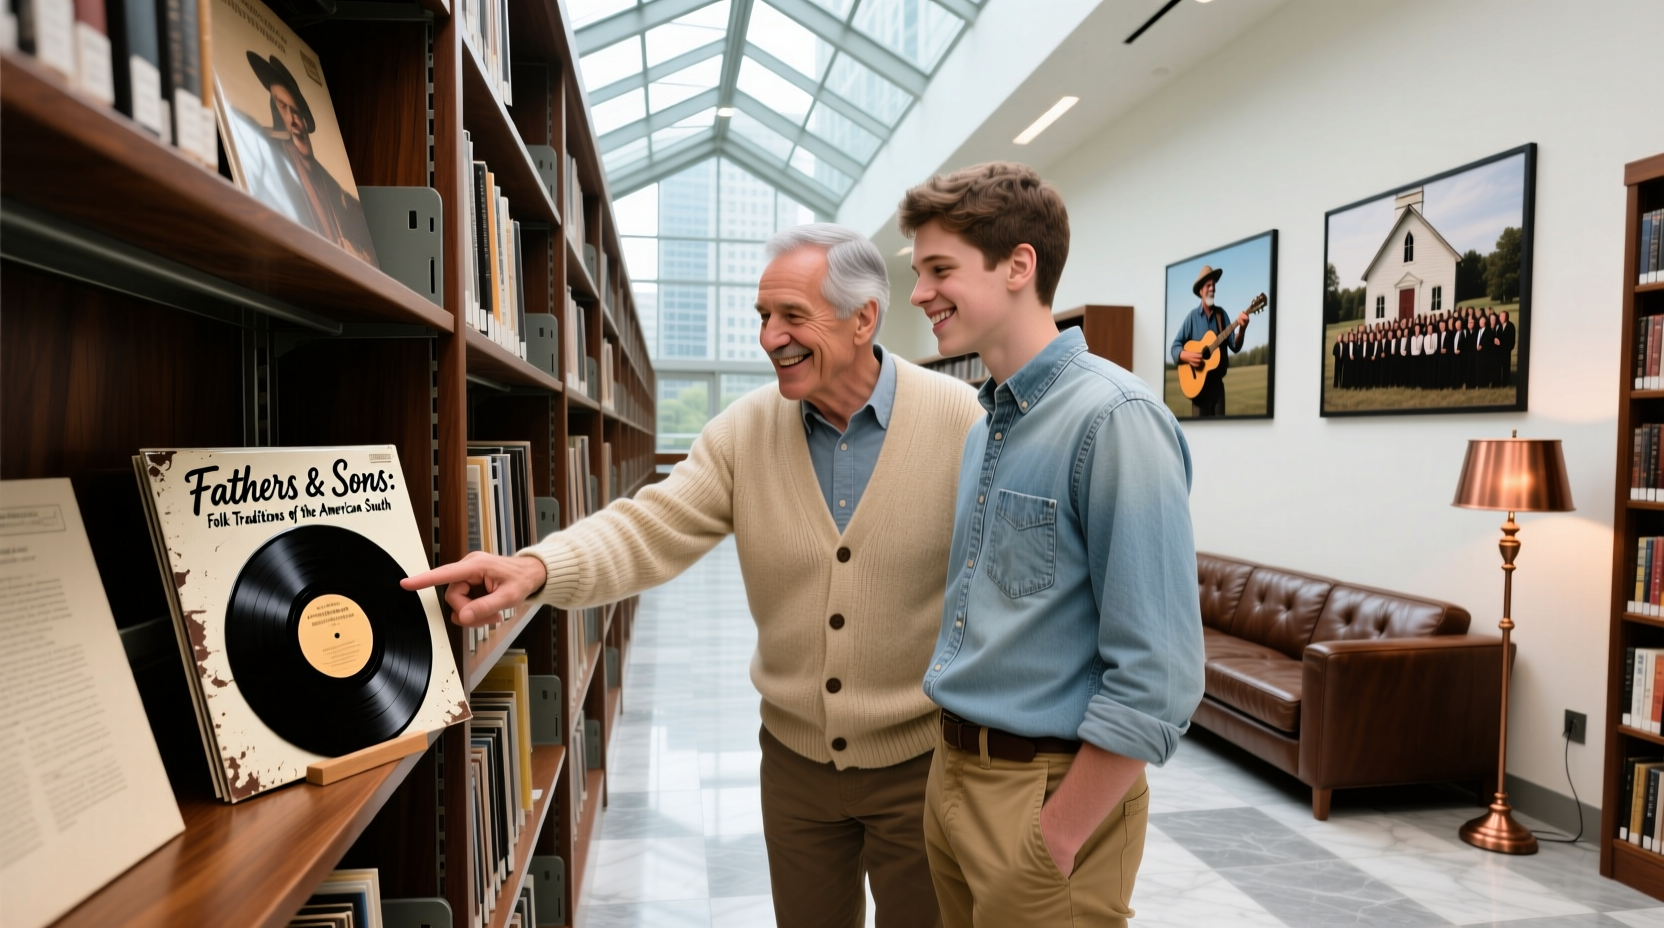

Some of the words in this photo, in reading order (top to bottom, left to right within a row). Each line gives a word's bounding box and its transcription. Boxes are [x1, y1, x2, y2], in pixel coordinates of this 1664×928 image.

[184, 465, 299, 516] Fathers
[305, 467, 325, 498] &
[331, 458, 396, 498] Sons:
[207, 511, 230, 529] Folk
[288, 505, 299, 524] of
[300, 503, 317, 518] the
